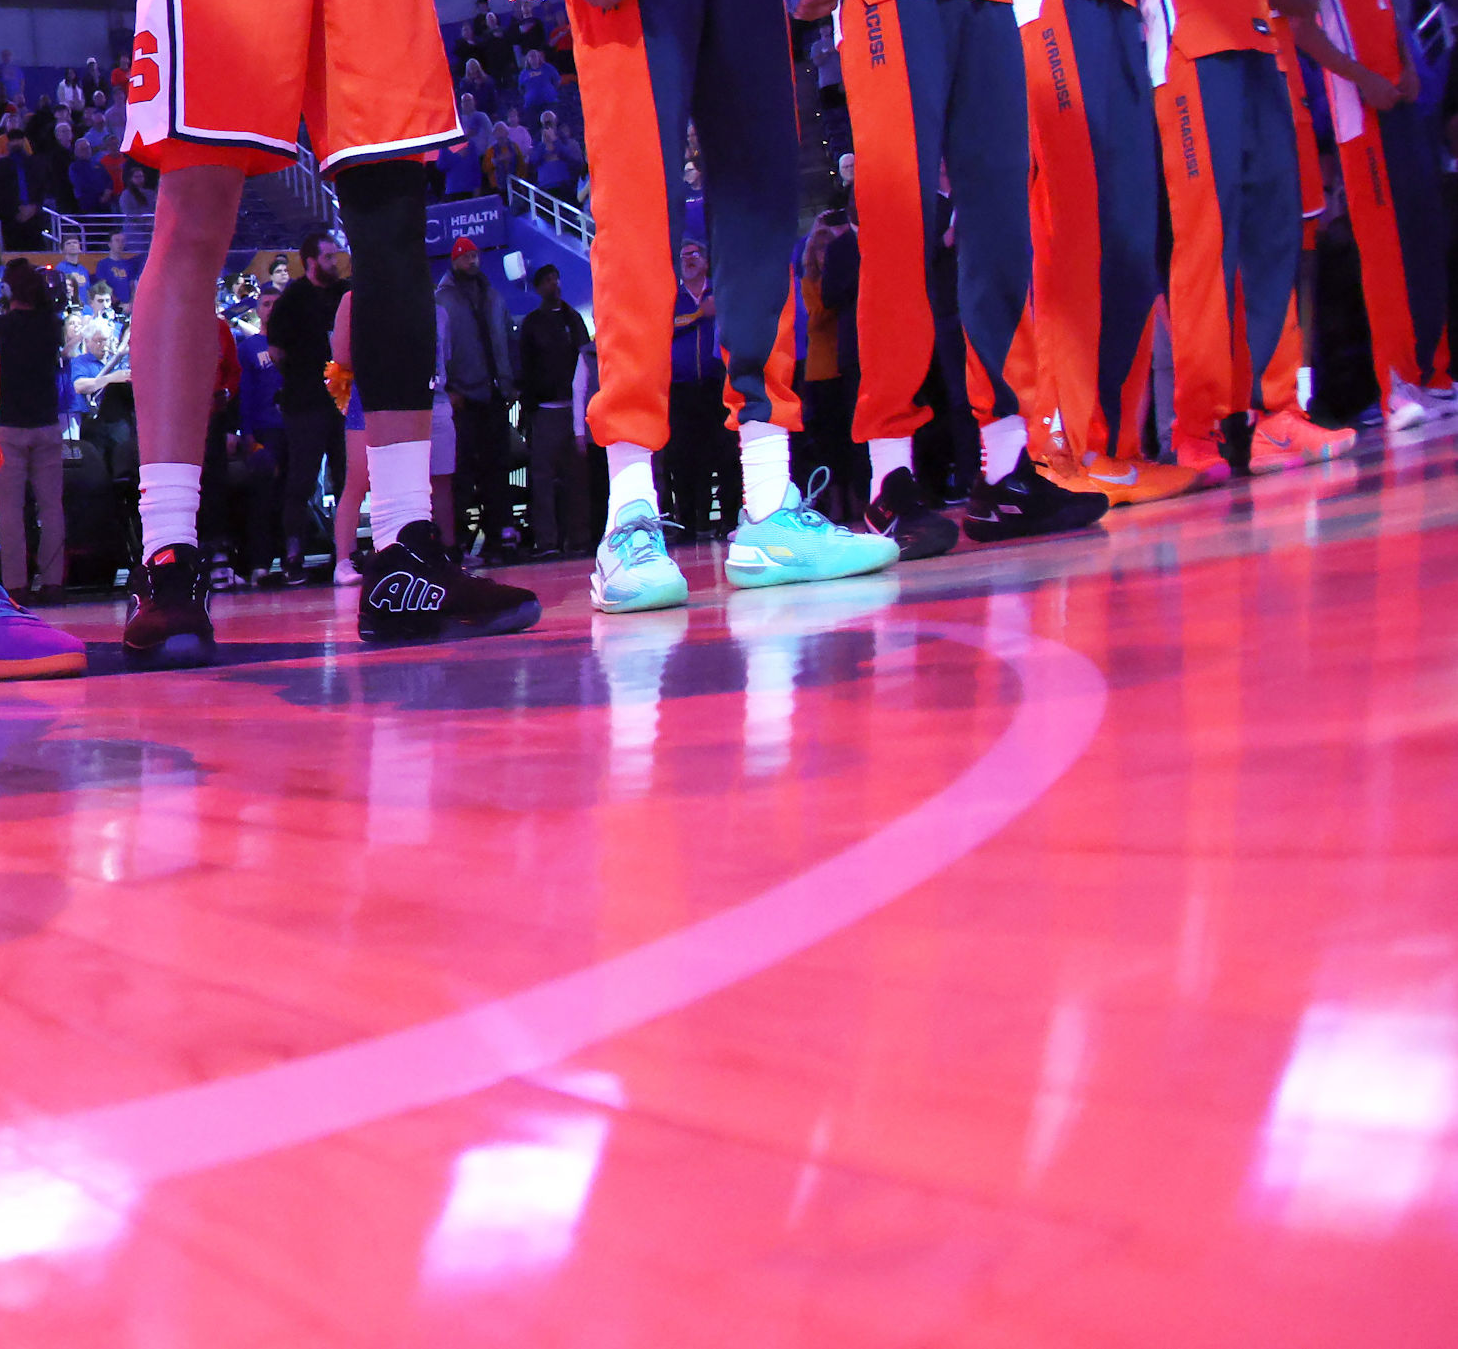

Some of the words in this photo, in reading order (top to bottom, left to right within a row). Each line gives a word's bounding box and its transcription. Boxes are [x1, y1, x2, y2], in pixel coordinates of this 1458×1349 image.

[1042, 27, 1073, 114] SYRACUSE
[450, 210, 498, 226] HEALTH
[452, 225, 485, 240] PLAN
[369, 571, 446, 613] AIR
